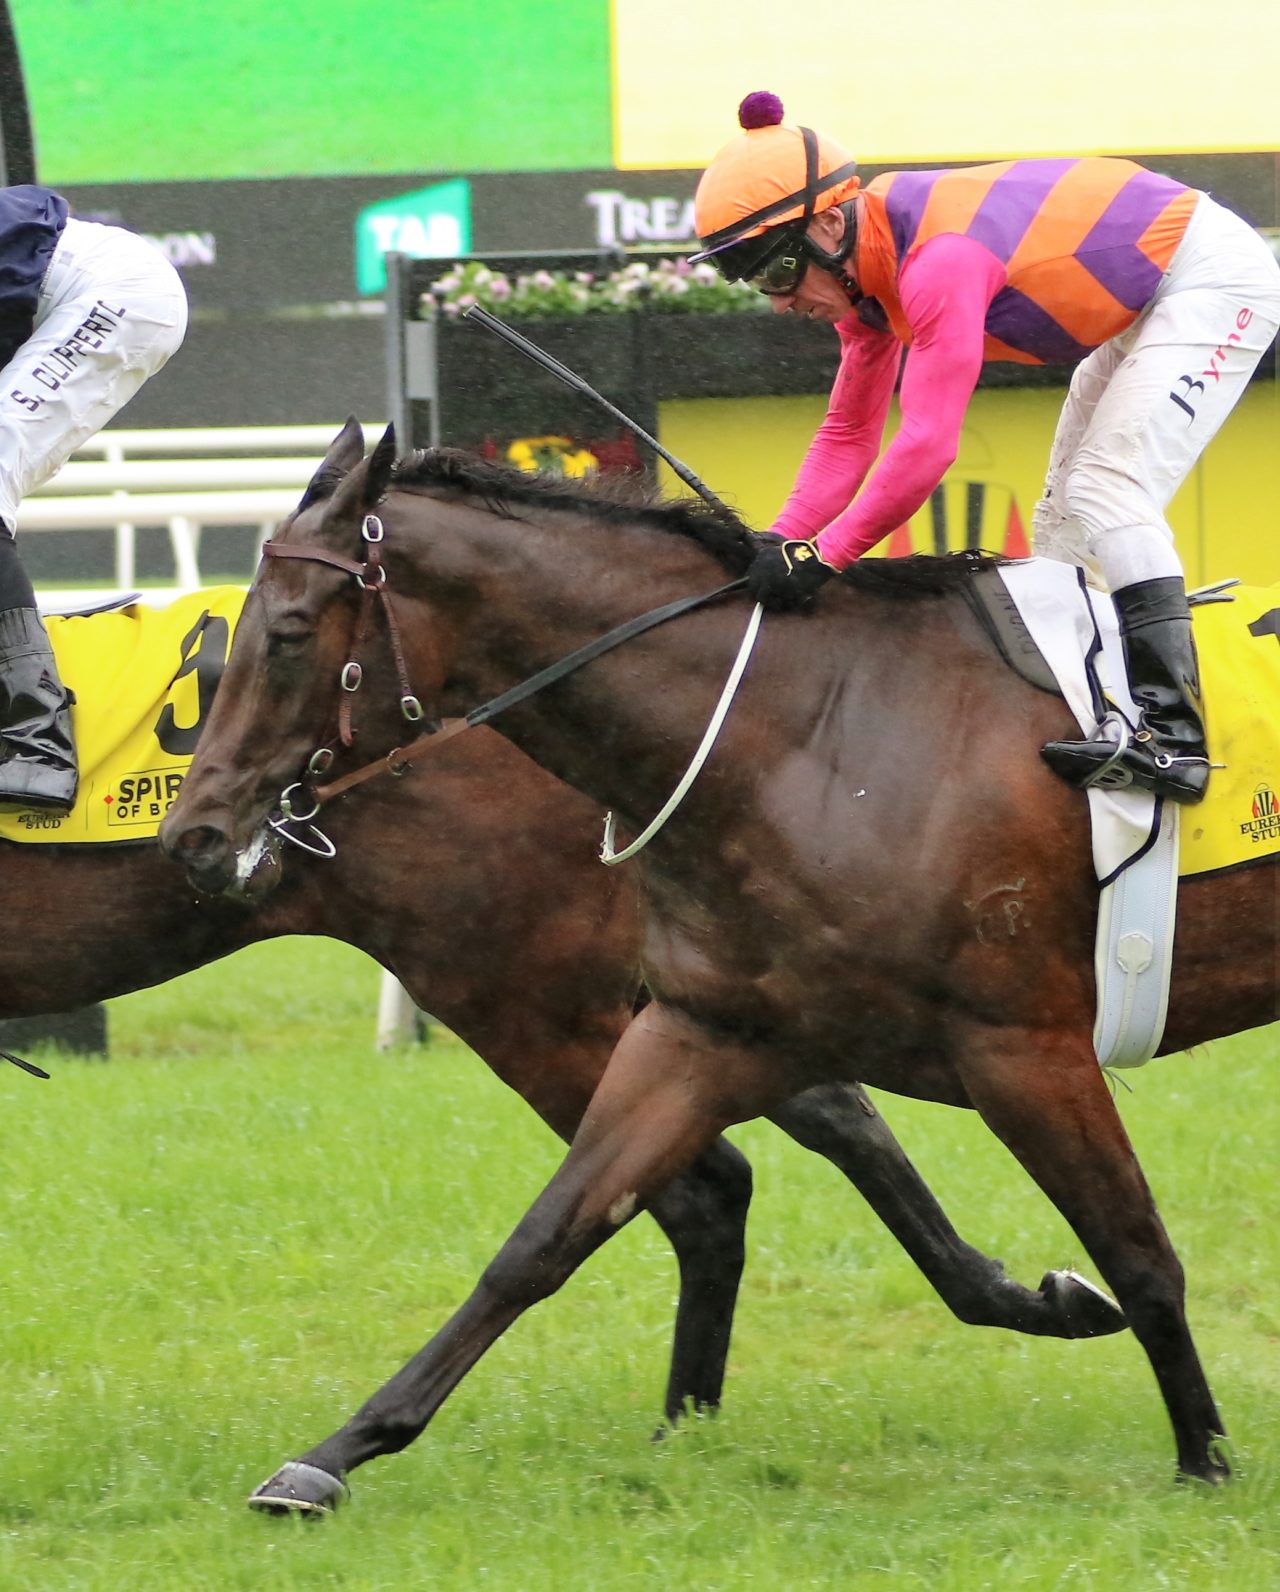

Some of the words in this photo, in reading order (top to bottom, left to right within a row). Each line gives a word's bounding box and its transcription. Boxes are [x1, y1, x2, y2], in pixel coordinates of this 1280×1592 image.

[10, 389, 46, 412] S.
[118, 773, 185, 804] SPIR
[116, 804, 140, 819] OF
[25, 818, 62, 830] STUD
[1251, 825, 1280, 843] STU
